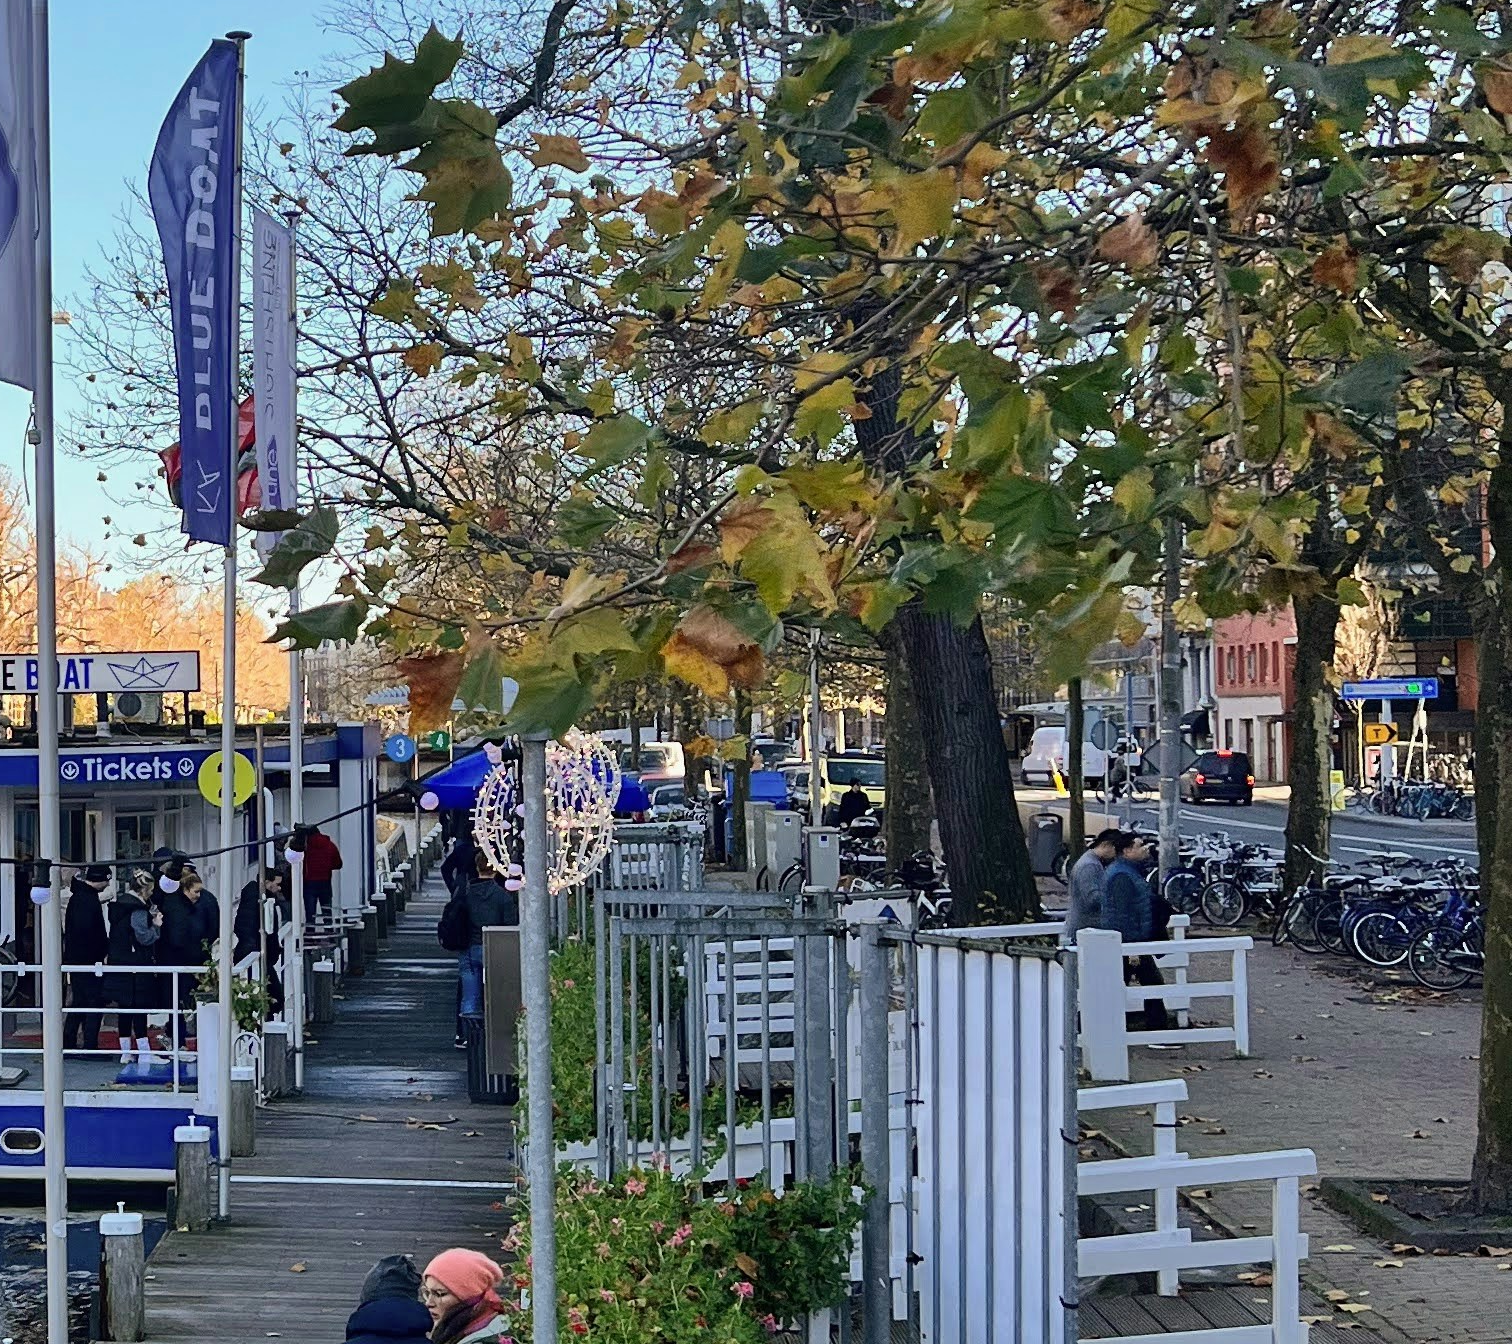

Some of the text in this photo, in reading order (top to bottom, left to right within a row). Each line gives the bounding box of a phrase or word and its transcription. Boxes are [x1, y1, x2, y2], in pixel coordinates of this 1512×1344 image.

[26, 658, 94, 690] BAT
[435, 733, 444, 748] 4
[1372, 728, 1382, 739] T
[395, 738, 406, 758] 3
[83, 757, 172, 781] Tickets
